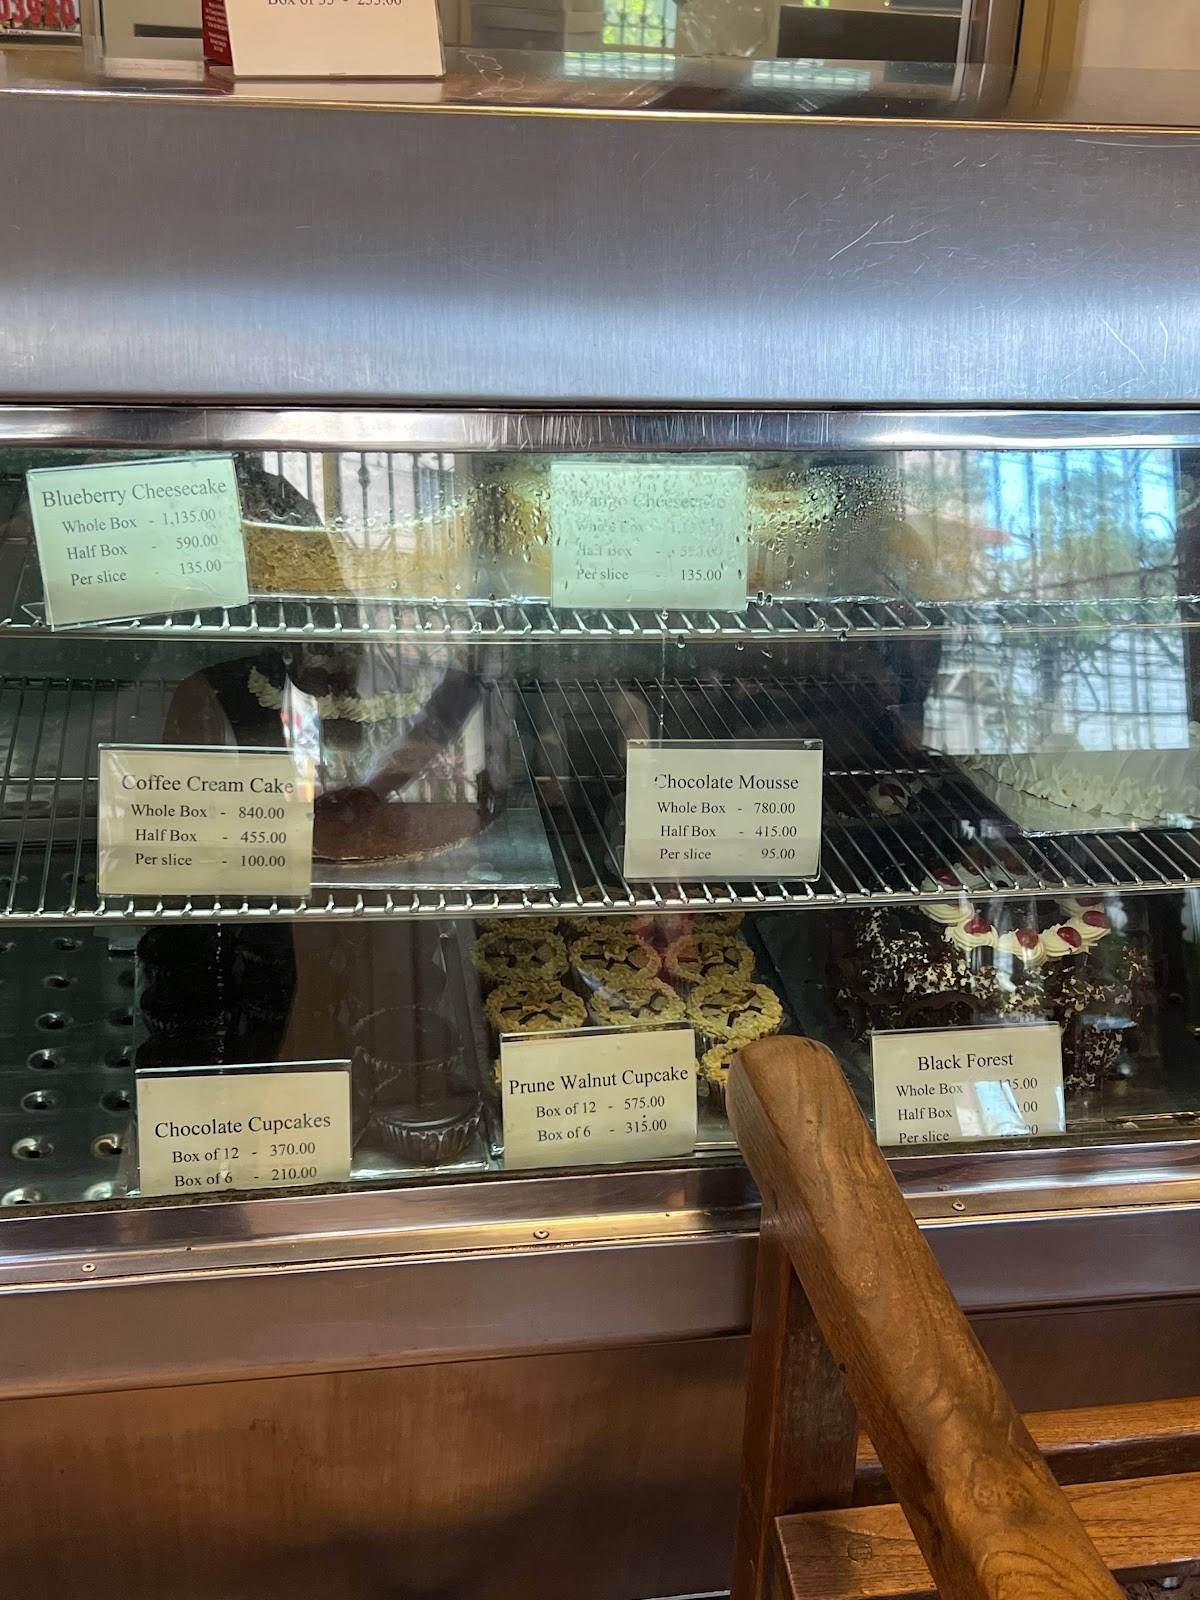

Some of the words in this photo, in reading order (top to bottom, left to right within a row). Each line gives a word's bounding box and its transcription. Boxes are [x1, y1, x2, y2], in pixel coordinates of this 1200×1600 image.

[42, 489, 126, 507] Blueberry
[132, 478, 227, 501] Cheesecake
[62, 519, 106, 533] Whole
[110, 517, 137, 530] Box
[162, 509, 215, 526] 1,135.00
[67, 546, 96, 560] Half
[101, 544, 128, 557] Box
[176, 534, 218, 550] 590.00
[71, 573, 94, 586] Per
[97, 570, 127, 584] slice
[180, 559, 221, 575] 135.00
[576, 570, 597, 580] Per
[600, 568, 629, 580] slice
[681, 569, 722, 581] 135.00
[122, 775, 181, 791] Coffee
[187, 776, 243, 792] Cream
[250, 778, 294, 794] Cake
[654, 774, 734, 790] Chocolate
[738, 775, 799, 790] Mousse
[131, 804, 175, 817] Whole
[180, 805, 207, 818] Box
[238, 807, 285, 819] 840.00
[657, 802, 697, 814] Whole
[701, 802, 726, 814] Box
[754, 802, 795, 814] 780.00
[136, 829, 167, 841] Half
[170, 830, 197, 842] Box
[240, 832, 287, 844] 455.00
[661, 825, 689, 837] Half
[692, 826, 716, 837] Box
[755, 826, 797, 837] 415.00
[135, 853, 158, 865] Per
[161, 853, 192, 866] slice
[241, 855, 286, 867] 100.00
[660, 849, 680, 860] Per
[684, 848, 712, 860] slice
[761, 849, 795, 860] 95.00
[918, 1054, 962, 1071] Black
[967, 1053, 1014, 1068] Forest
[509, 1079, 555, 1094] Prune
[560, 1073, 617, 1090] Walnut
[622, 1066, 688, 1087] Cupcake
[896, 1084, 936, 1097] Whole
[939, 1083, 964, 1095] Box
[536, 1106, 561, 1118] Box
[565, 1103, 579, 1115] of
[583, 1102, 597, 1114] 12
[624, 1096, 665, 1110] 575.00
[898, 1108, 926, 1121] Half
[928, 1107, 952, 1119] Box
[154, 1118, 243, 1138] Chocolate
[248, 1113, 331, 1134] Cupcakes
[538, 1130, 563, 1142] Box
[567, 1126, 582, 1139] of
[583, 1126, 591, 1138] 6
[625, 1119, 667, 1134] 315.00
[899, 1132, 919, 1144] Per
[921, 1130, 949, 1143] slice
[172, 1150, 200, 1163] Box
[205, 1147, 221, 1160] of
[224, 1147, 239, 1160] 12
[269, 1142, 316, 1157] 370.00
[175, 1175, 201, 1187] Box
[206, 1172, 222, 1185] of
[225, 1171, 233, 1184] 6
[271, 1167, 317, 1181] 210.00
